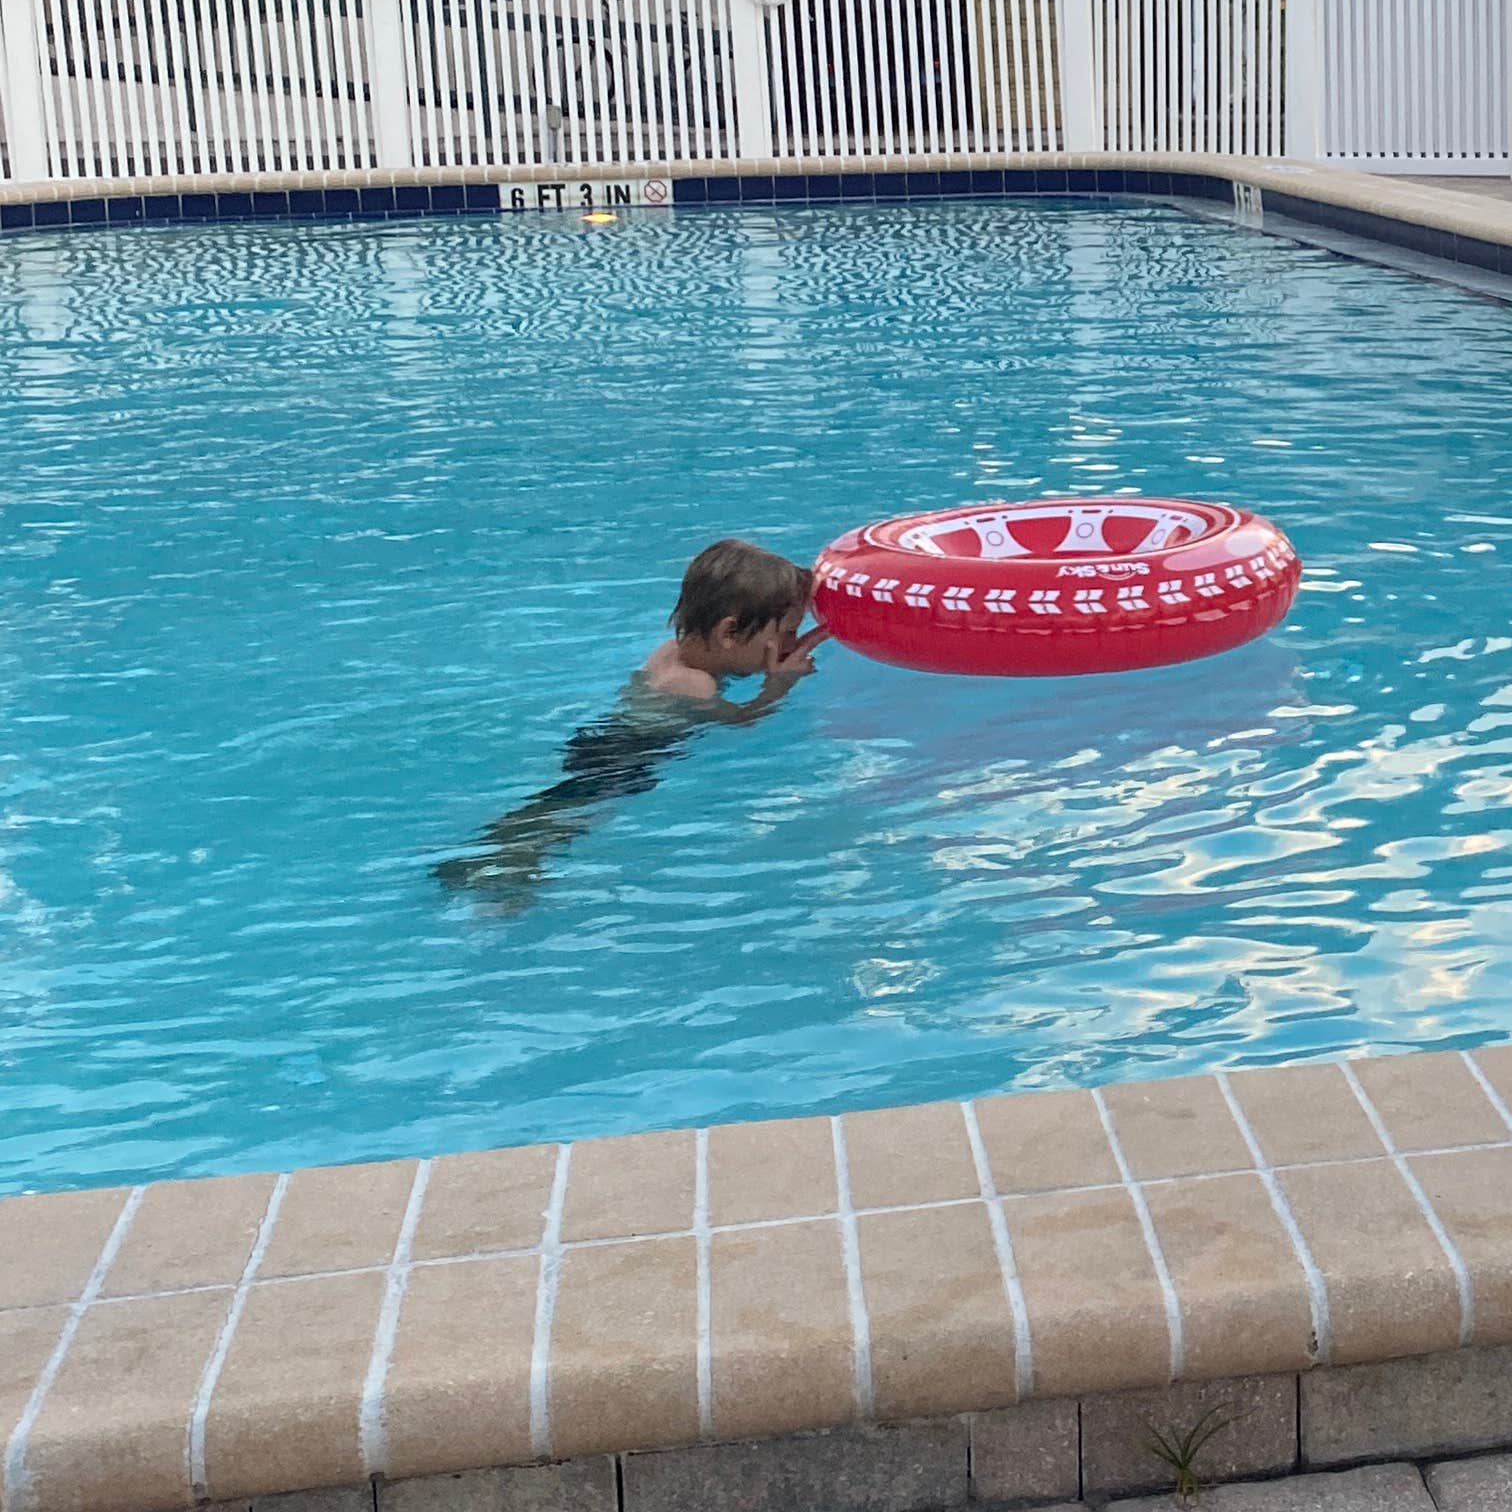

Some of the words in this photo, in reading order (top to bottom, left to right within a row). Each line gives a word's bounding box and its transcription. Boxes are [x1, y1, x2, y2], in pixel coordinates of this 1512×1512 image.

[511, 188, 524, 208] 6
[537, 184, 566, 210] FT
[579, 183, 593, 207] 3
[606, 185, 631, 204] IN
